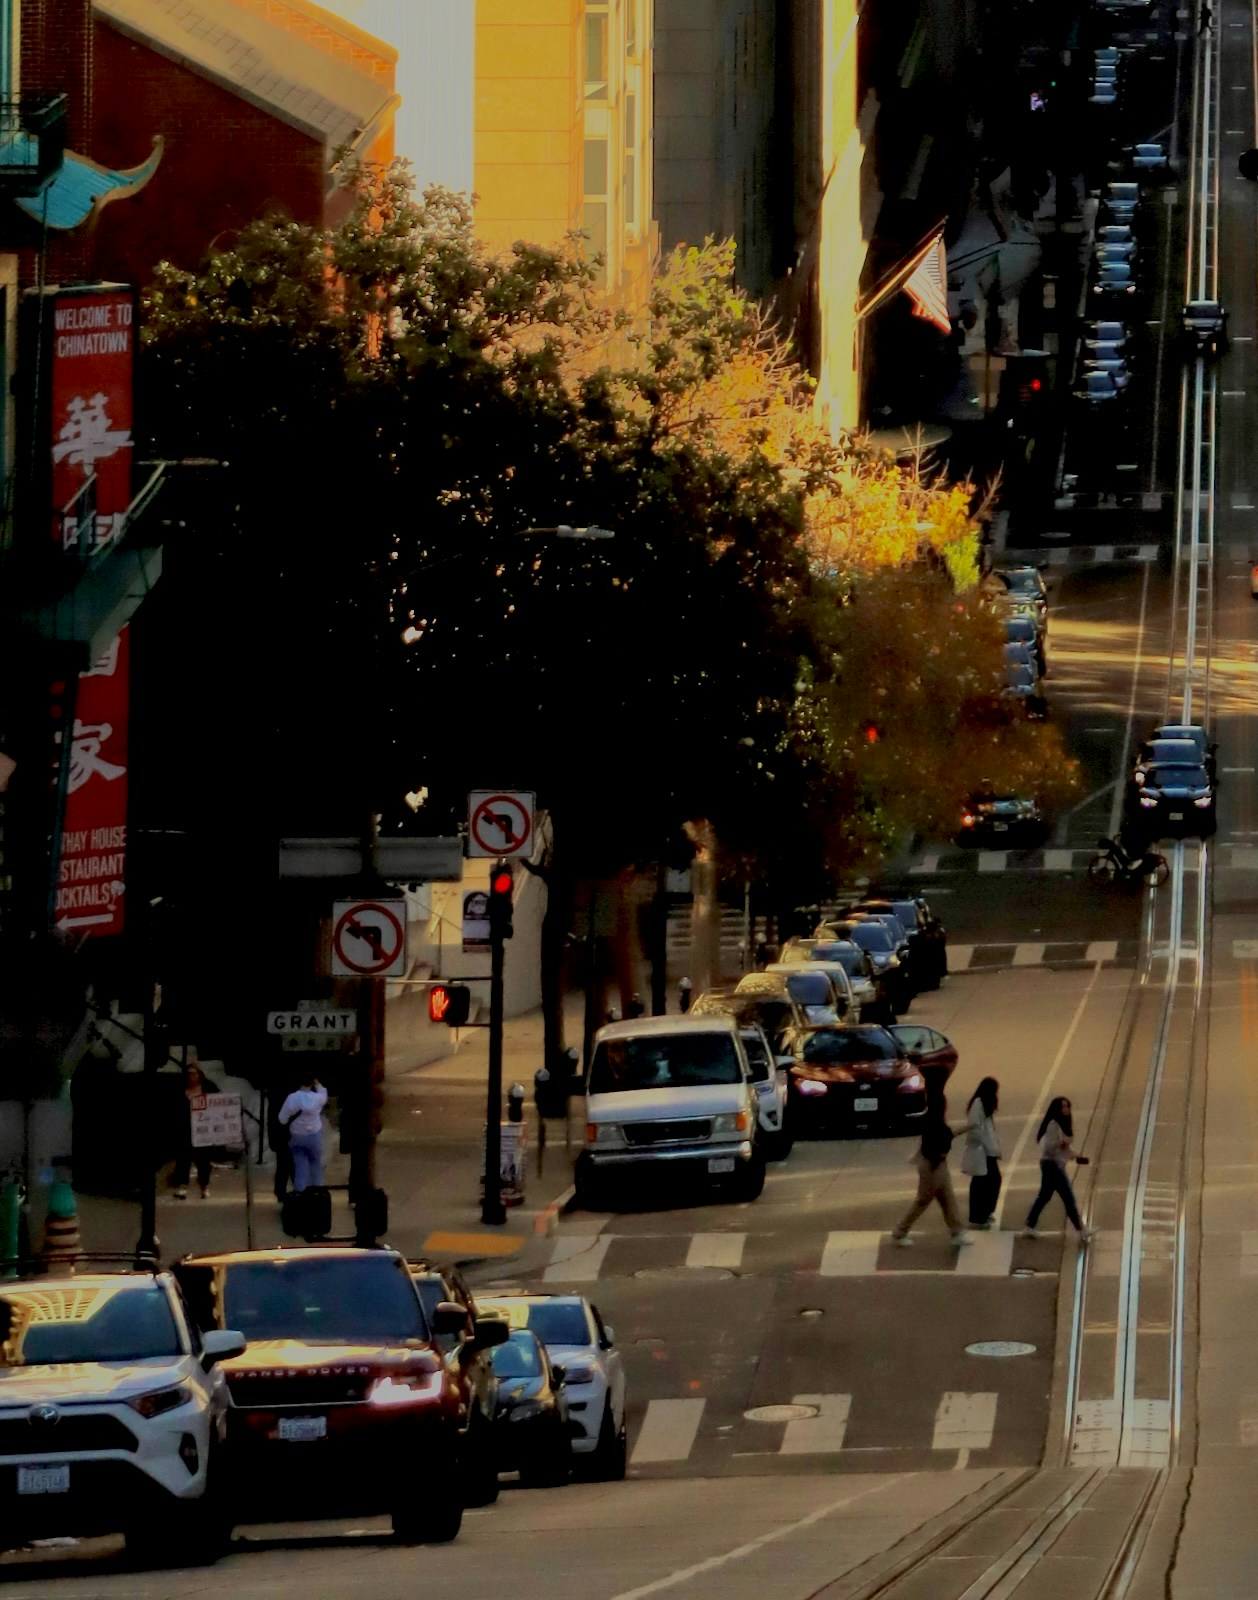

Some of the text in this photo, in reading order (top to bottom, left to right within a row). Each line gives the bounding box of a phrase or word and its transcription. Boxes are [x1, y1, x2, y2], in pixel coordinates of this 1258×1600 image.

[55, 303, 133, 330] WELCOME TO
[57, 332, 128, 357] CHINATOWN
[90, 825, 127, 849] HOUSE
[58, 853, 126, 882] STAURANT
[54, 882, 110, 911] CKTAILS
[274, 1015, 349, 1029] GRANT
[235, 1365, 370, 1379] RANGE ROVER
